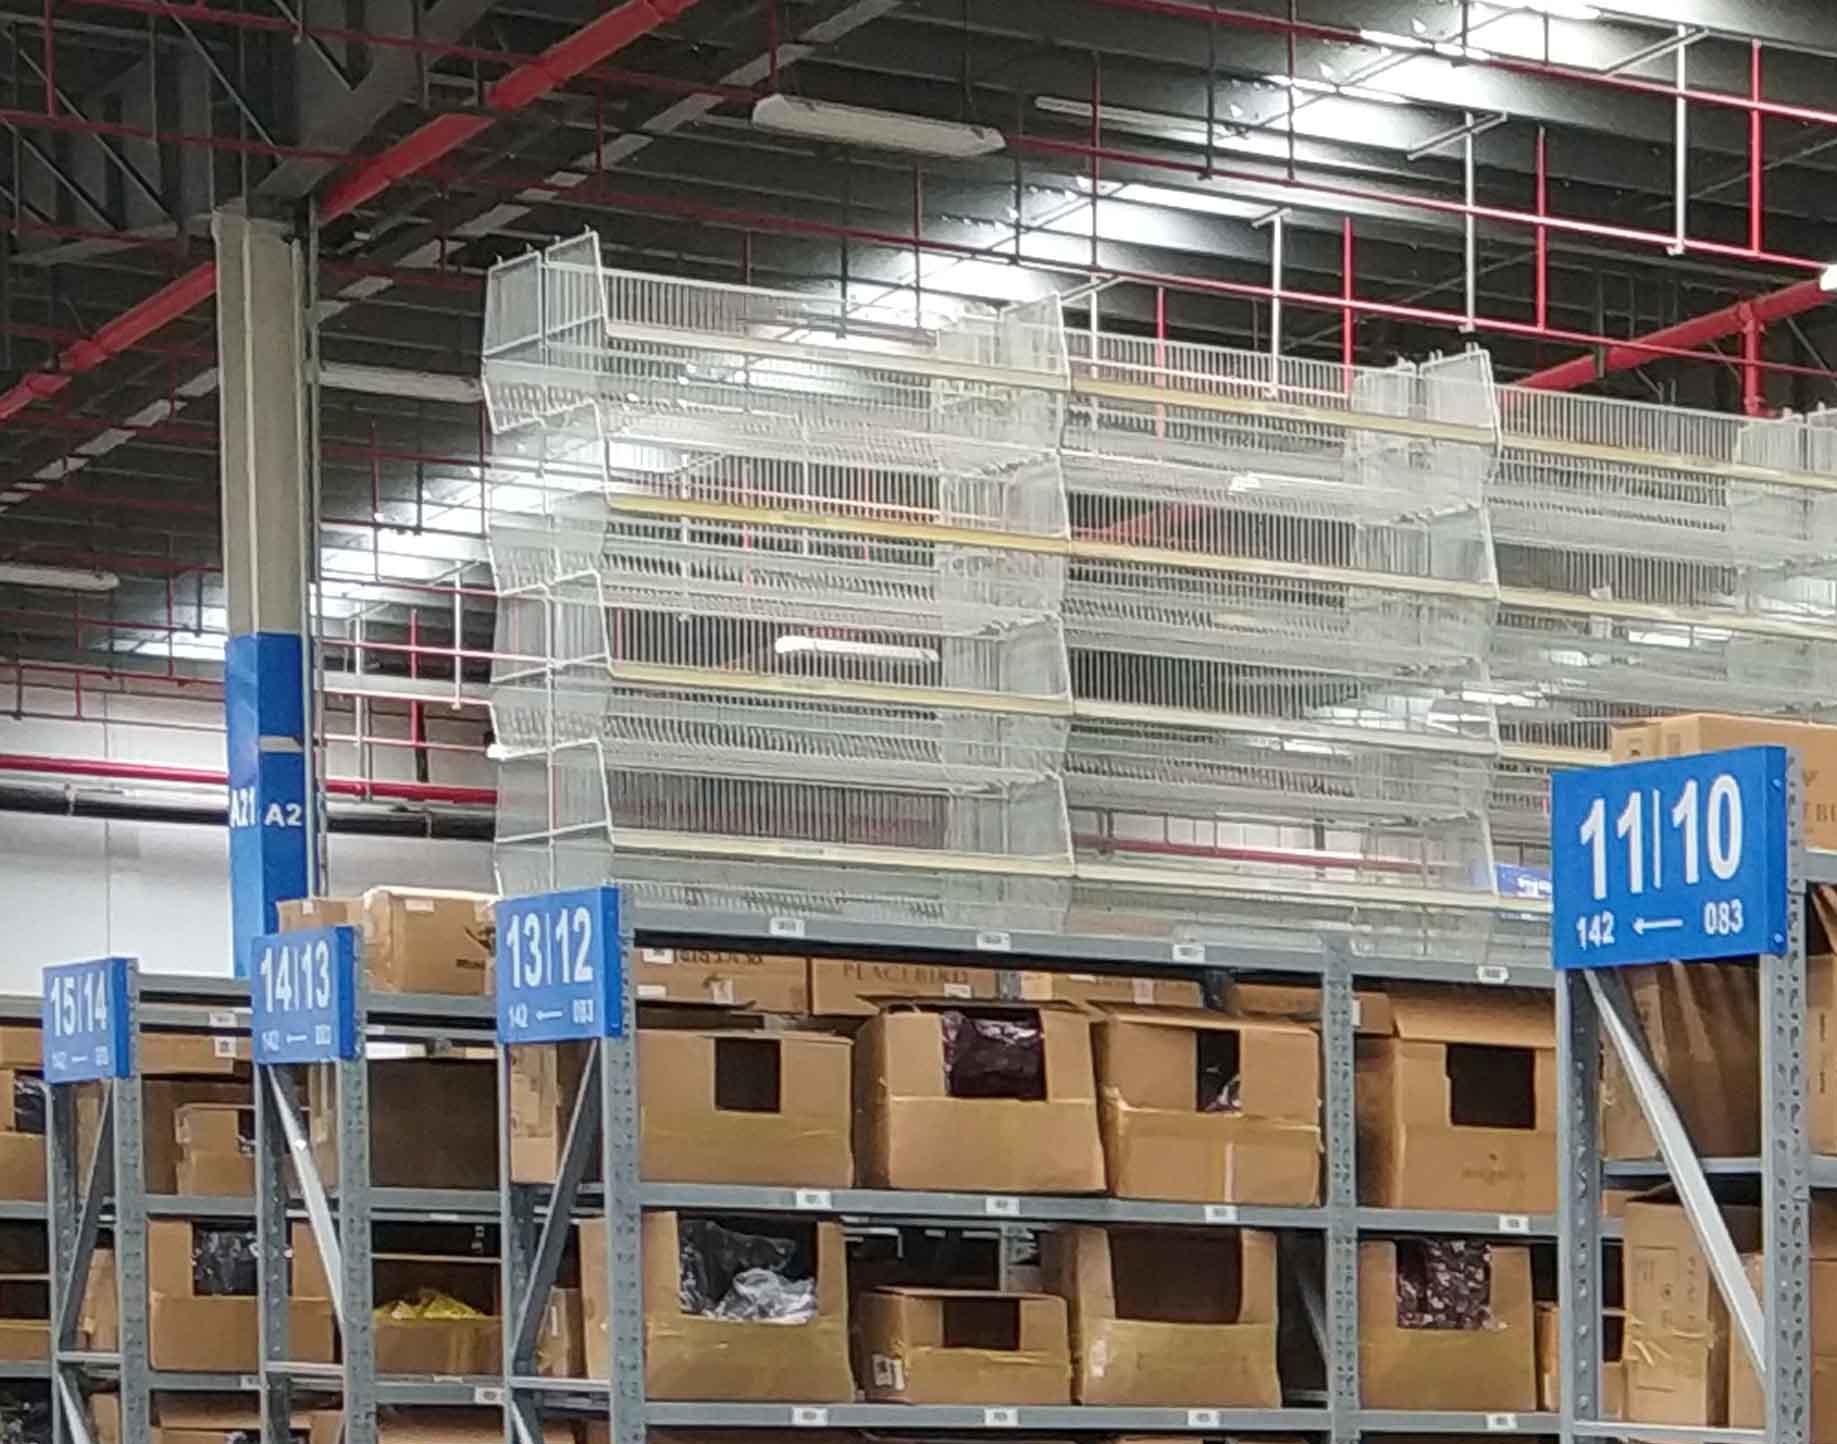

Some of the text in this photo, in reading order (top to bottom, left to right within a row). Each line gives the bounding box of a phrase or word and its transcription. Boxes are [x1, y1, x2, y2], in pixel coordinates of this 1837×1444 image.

[264, 803, 302, 827] A2
[1576, 898, 1744, 948] 142 083
